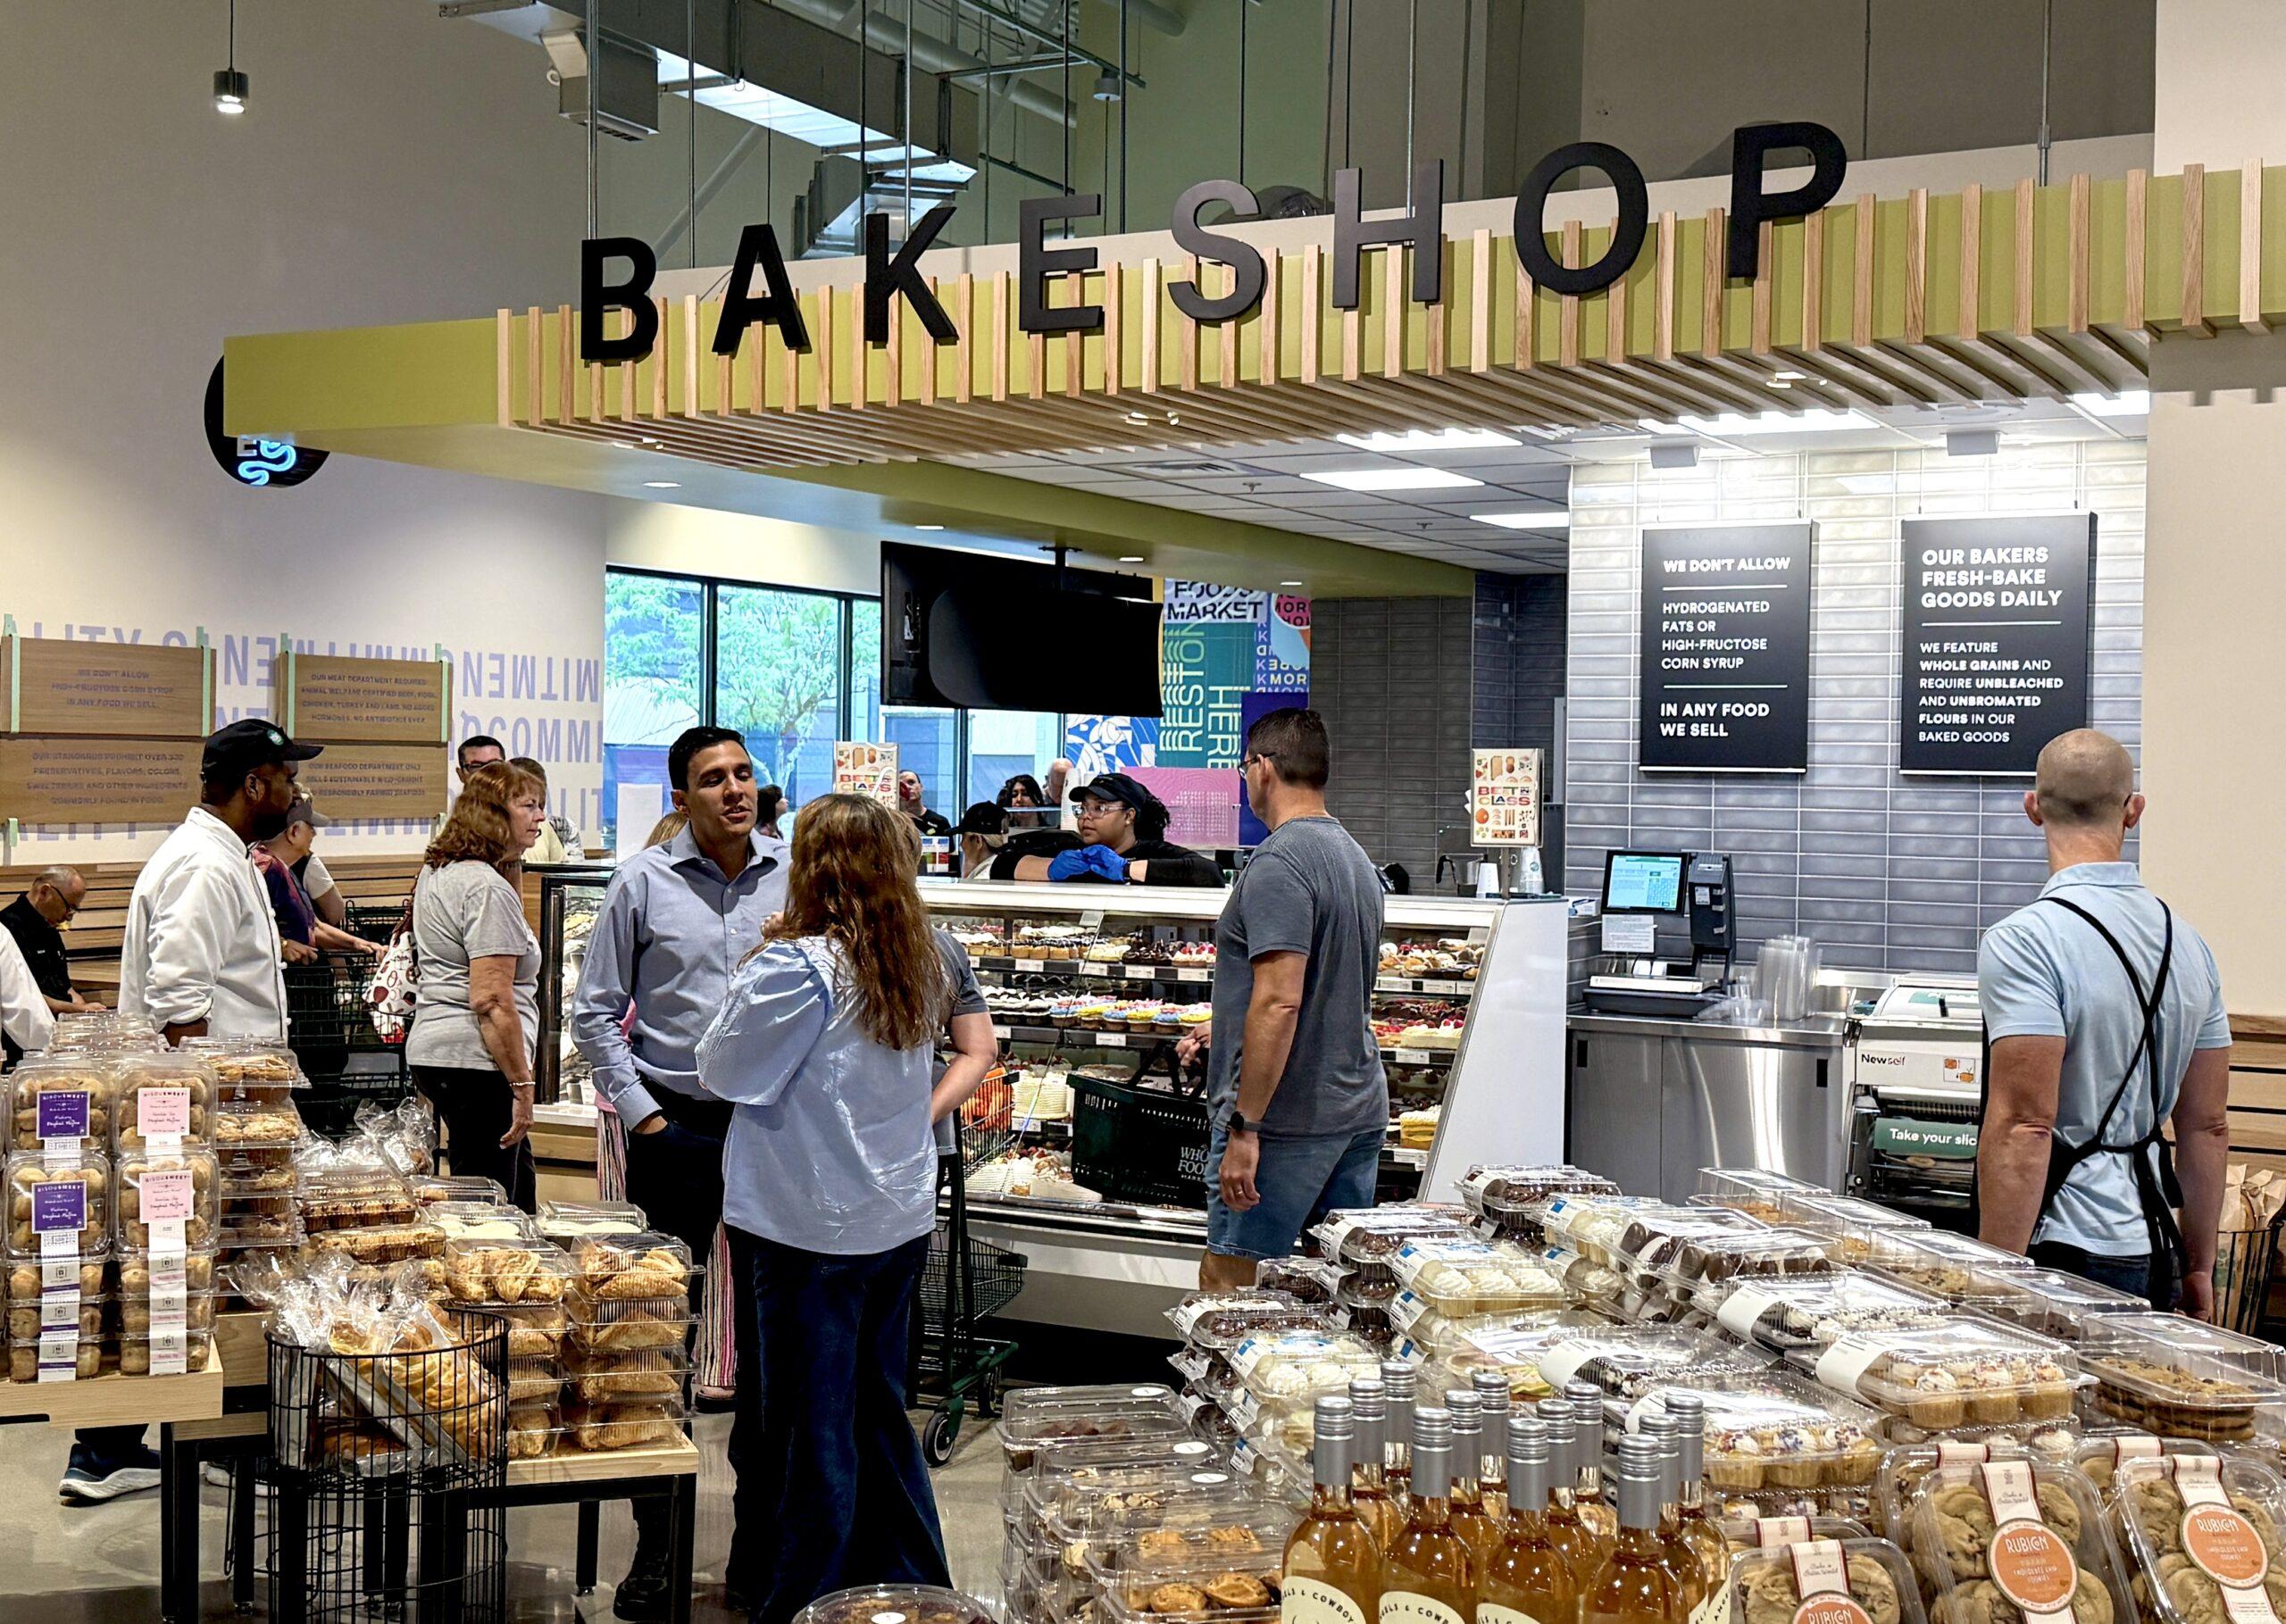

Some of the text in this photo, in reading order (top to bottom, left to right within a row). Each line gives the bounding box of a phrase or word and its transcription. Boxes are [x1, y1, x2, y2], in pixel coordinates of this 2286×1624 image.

[1664, 556, 1791, 572] WE DON'T ALLOW
[1922, 546, 2048, 567] OUR BAKERS
[1922, 569, 2046, 587] FRESH-BAKE
[1921, 589, 2063, 609] GOODS DAILY
[1167, 601, 1264, 620] MARKET
[1662, 600, 1770, 615] HYDROGENATED
[1662, 620, 1716, 633] FATS OR
[1662, 637, 1768, 652] HIGH-FRUCTOSE
[1920, 641, 1998, 654] WE FEATURE
[1661, 656, 1745, 670] CORN SYRUP
[1920, 659, 2051, 671] WHOLE GRAINS AND
[1920, 677, 2064, 690] REQUIRE UNBLEACHED
[1919, 695, 2041, 708] AND UNBROMATED
[1660, 702, 1770, 718] IN ANY FOOD
[1919, 712, 2015, 726] FLOURS IN OUR
[1659, 722, 1729, 737] WE SELL
[1918, 731, 2010, 744] BAKED GOODS
[1890, 1128, 1977, 1146] Take your slic
[1313, 1592, 1355, 1623] COWBOY
